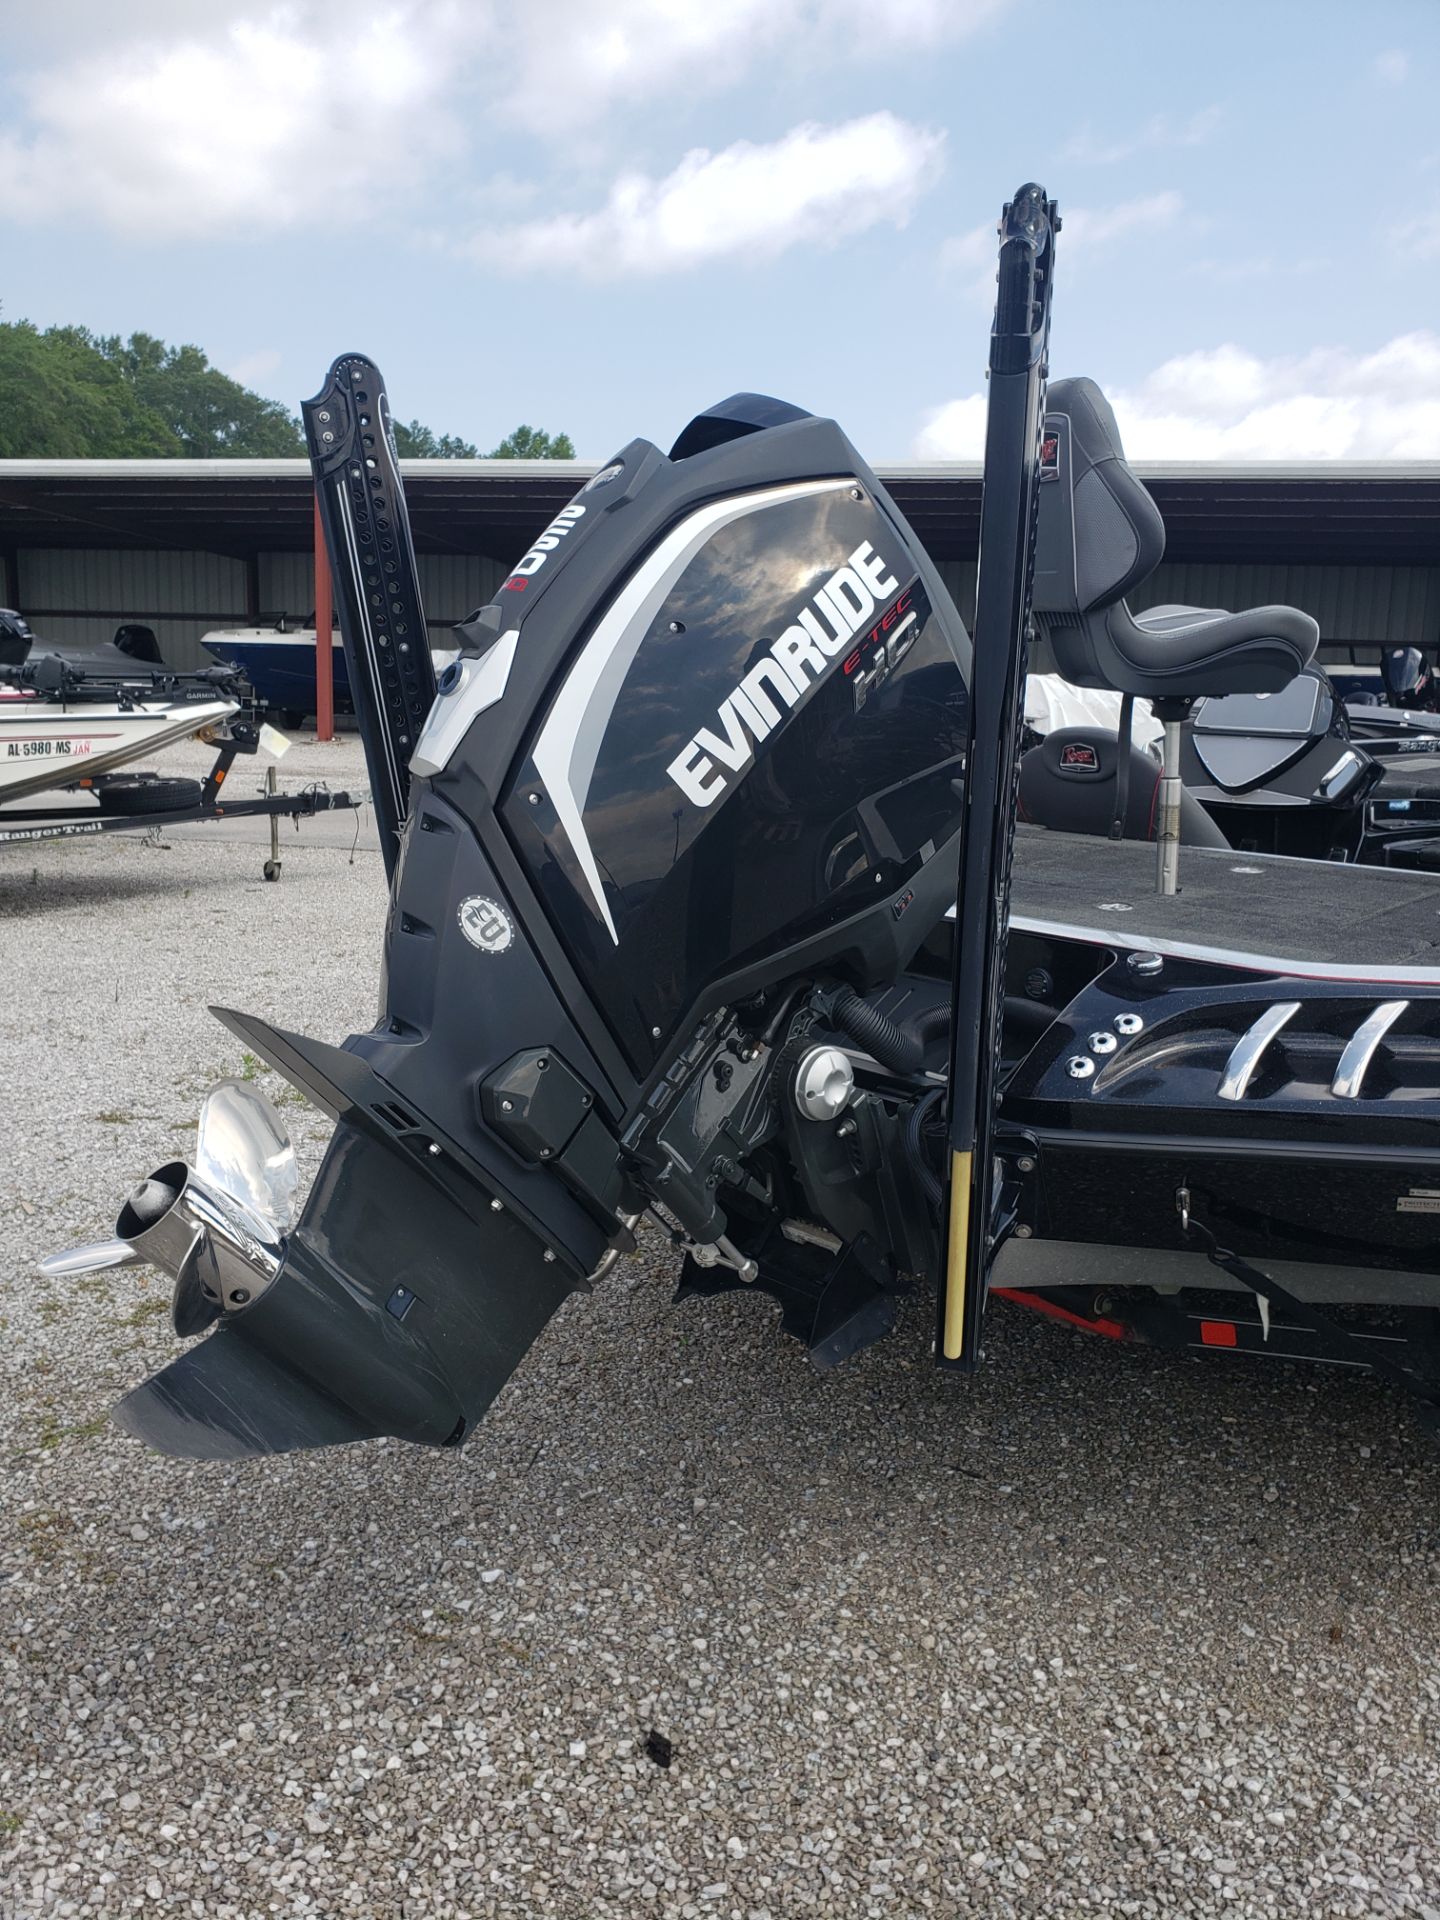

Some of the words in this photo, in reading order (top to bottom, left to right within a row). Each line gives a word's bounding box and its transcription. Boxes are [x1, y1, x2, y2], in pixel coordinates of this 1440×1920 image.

[842, 588, 912, 676] E-TEC
[665, 539, 900, 808] EVINRUDE
[186, 692, 216, 700] GARMIN
[7, 743, 20, 757] AL
[23, 741, 52, 756] 5980
[55, 740, 71, 755] MS
[0, 827, 61, 841] Ranger
[62, 821, 103, 835] Trail
